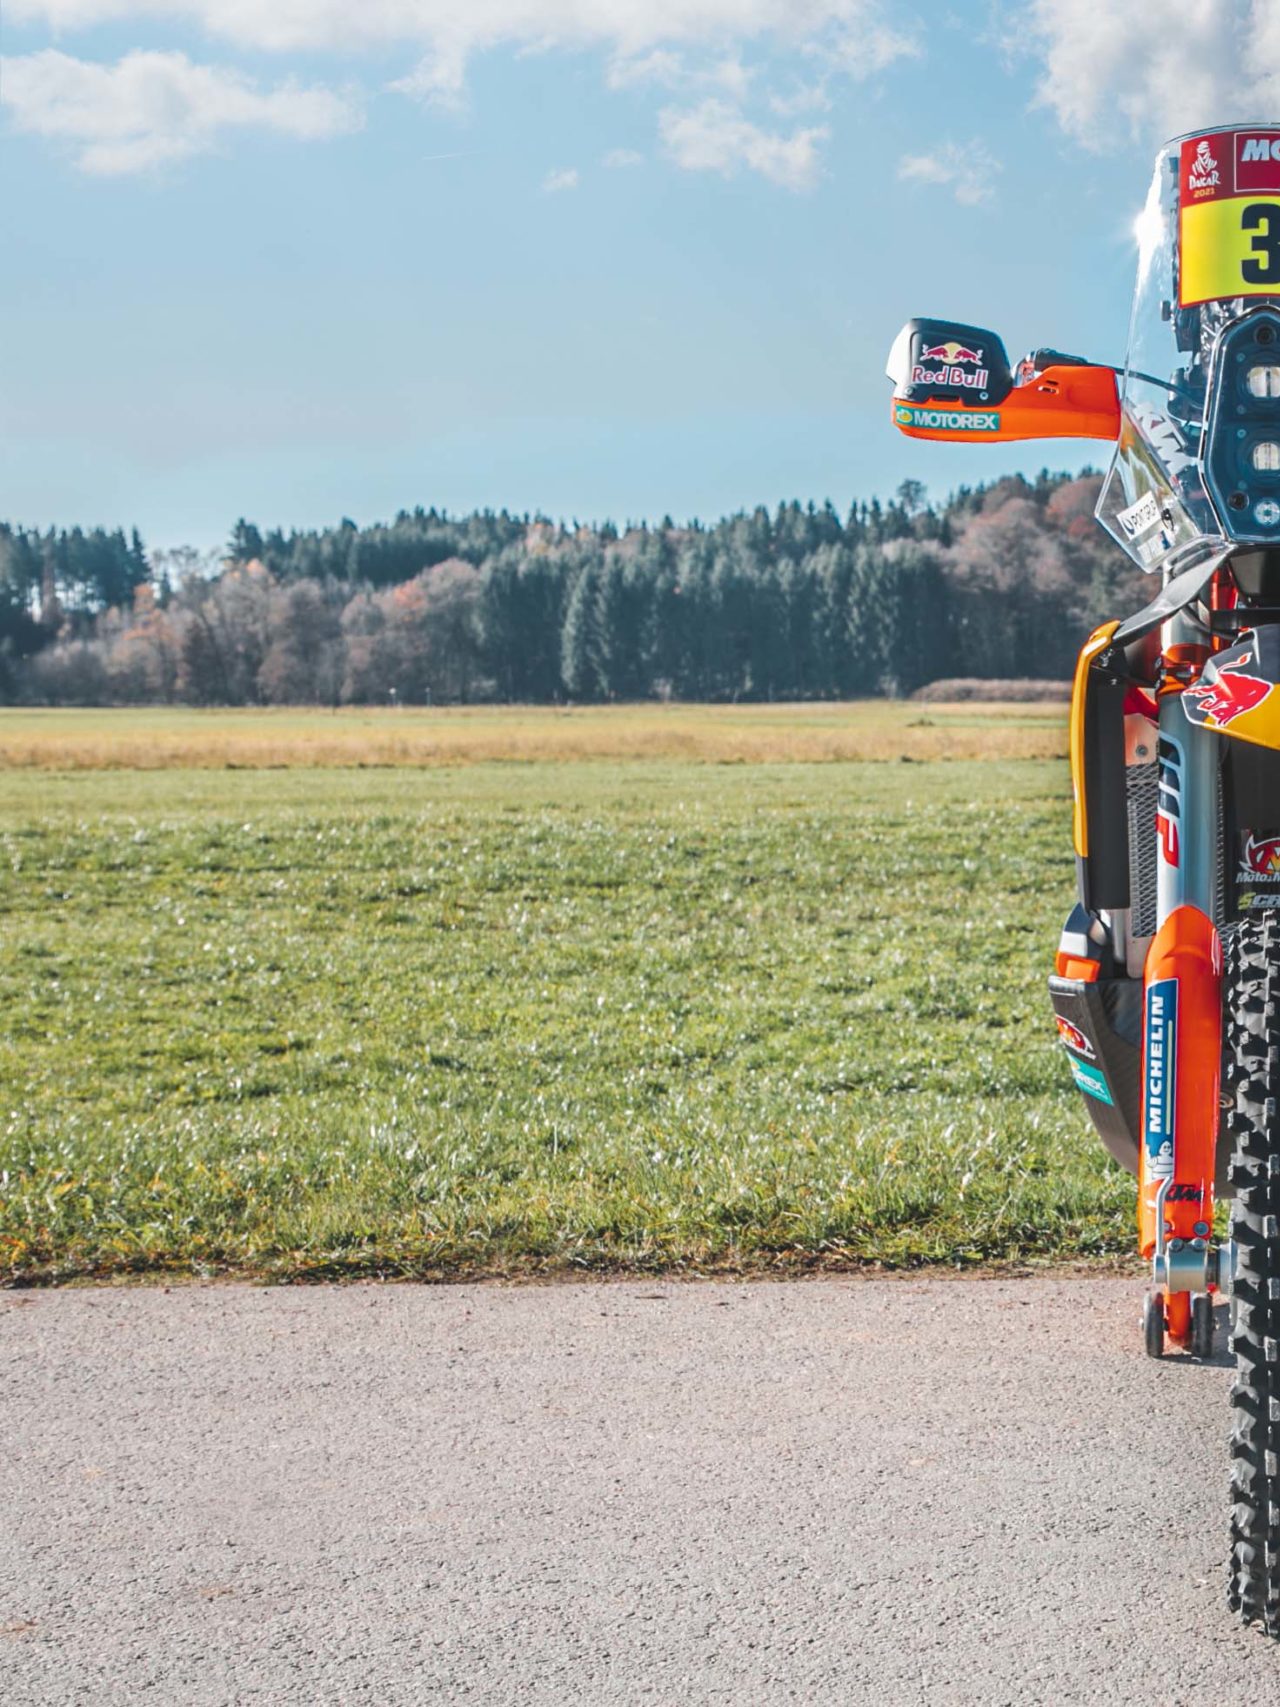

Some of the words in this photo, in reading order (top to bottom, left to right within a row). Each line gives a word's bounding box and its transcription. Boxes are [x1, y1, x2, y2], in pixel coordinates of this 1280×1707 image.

[912, 365, 949, 384] Red
[950, 367, 989, 390] Bull
[914, 410, 996, 430] MOTOREX
[1150, 995, 1164, 1133] MICHELIN
